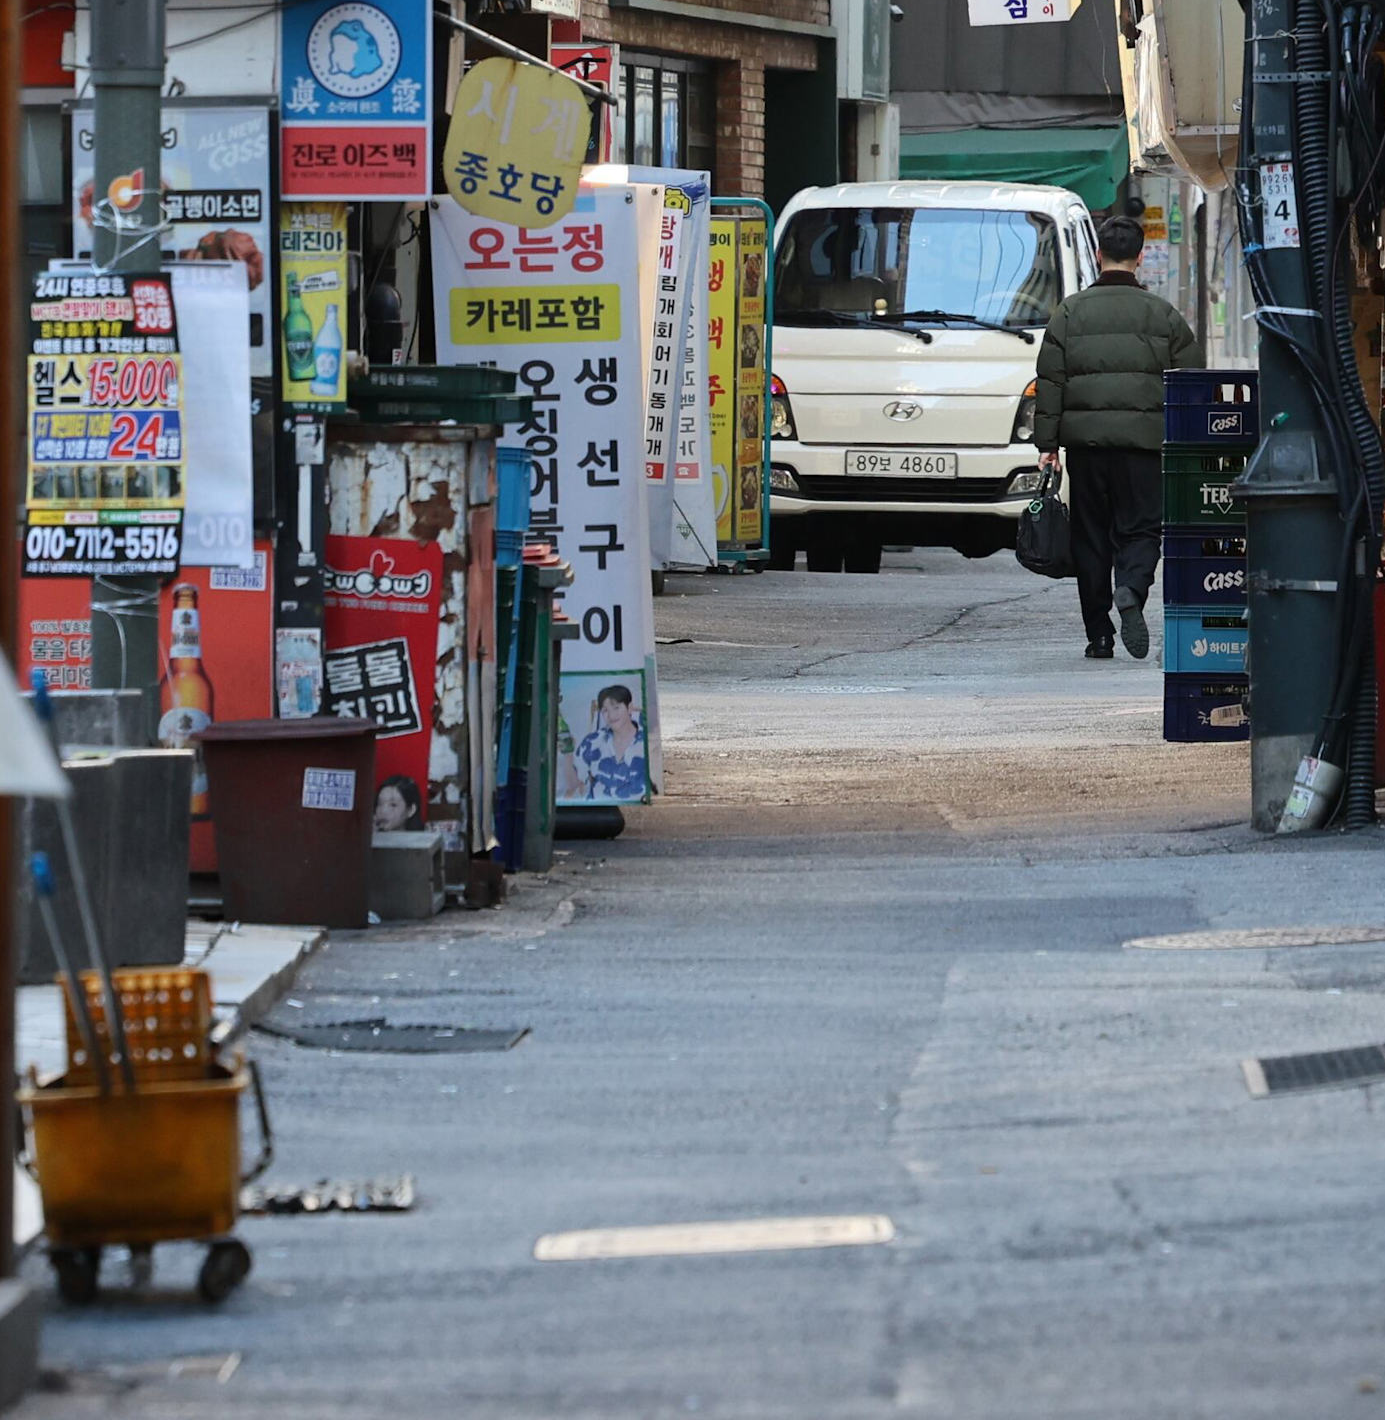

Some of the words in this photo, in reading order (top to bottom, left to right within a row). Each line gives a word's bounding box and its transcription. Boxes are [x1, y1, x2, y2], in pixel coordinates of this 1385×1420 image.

[466, 78, 583, 163] 시계
[292, 142, 338, 168] 진로
[455, 150, 566, 216] 종호당
[165, 195, 261, 219] 골뱅이소면
[1274, 200, 1291, 221] 4
[281, 230, 344, 253] 테진아
[465, 223, 605, 273] 오는정
[465, 295, 606, 333] 카레포함
[34, 360, 83, 405] 헬스
[1211, 414, 1239, 433] Cass
[899, 456, 947, 474] 4860
[573, 356, 625, 652] 생선구이
[1200, 483, 1234, 505] TER
[25, 525, 180, 560] 010-7112-5516
[1203, 568, 1244, 593] Cass
